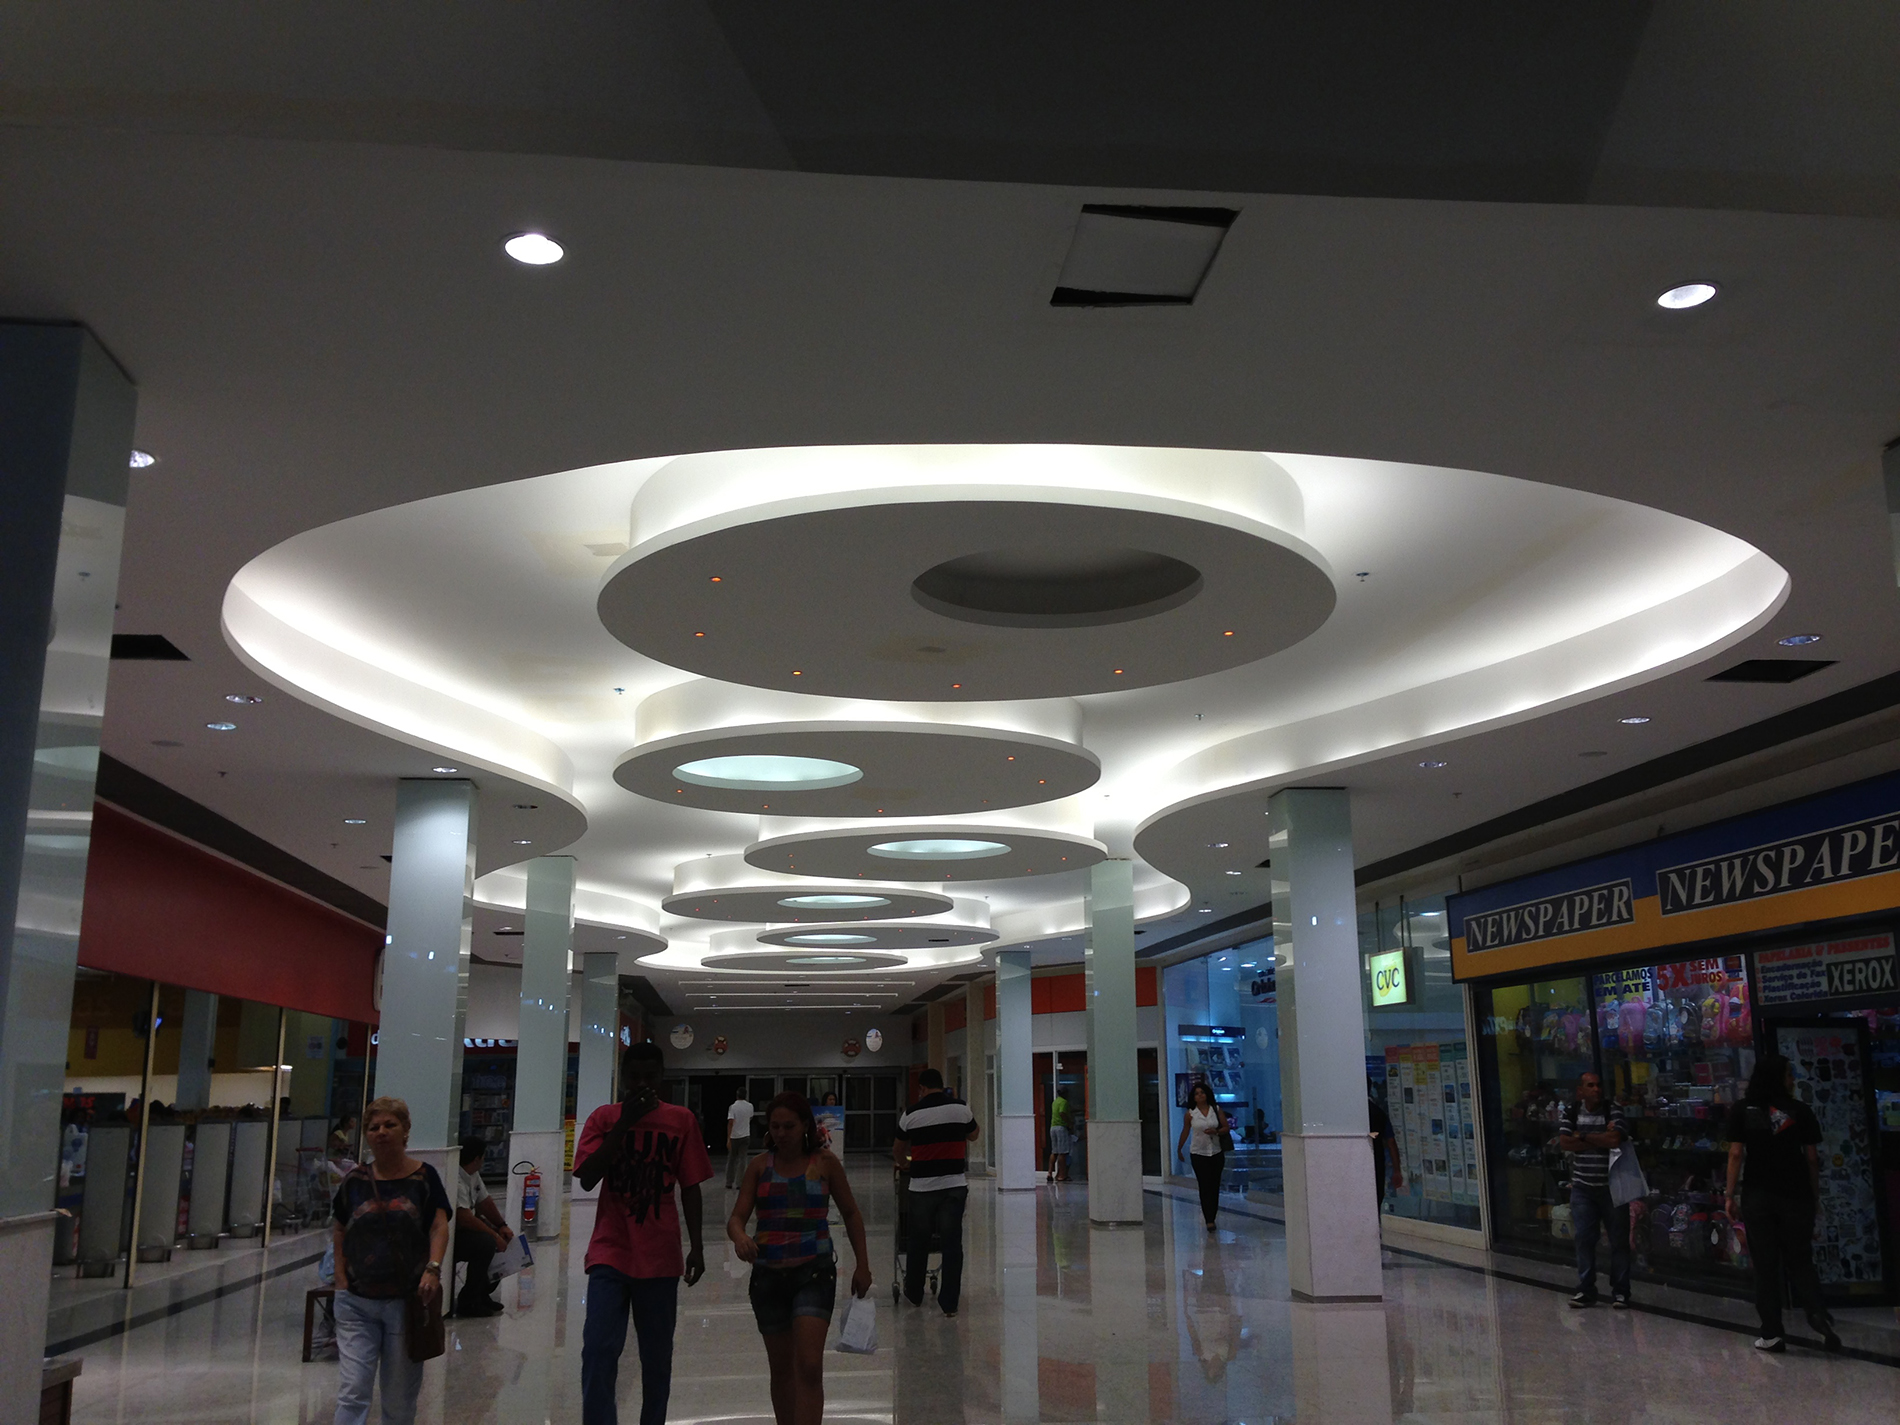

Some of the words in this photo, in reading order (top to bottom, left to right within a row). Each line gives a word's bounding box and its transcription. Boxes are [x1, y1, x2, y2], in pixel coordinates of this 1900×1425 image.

[1665, 820, 1900, 910] NEWSPAPE
[1469, 885, 1631, 950] NEWSPAPER
[1593, 967, 1653, 985] PARCELAMOS
[1690, 958, 1719, 972] SEM
[1831, 958, 1895, 993] XEROX
[1376, 967, 1400, 991] CVC
[1657, 962, 1690, 992] 5X
[1690, 970, 1722, 985] JUROS
[1762, 973, 1794, 984] Serviço
[1796, 971, 1807, 980] de
[1810, 969, 1827, 978] Fax
[1594, 986, 1617, 998] EM
[1622, 978, 1651, 995] ATÉ
